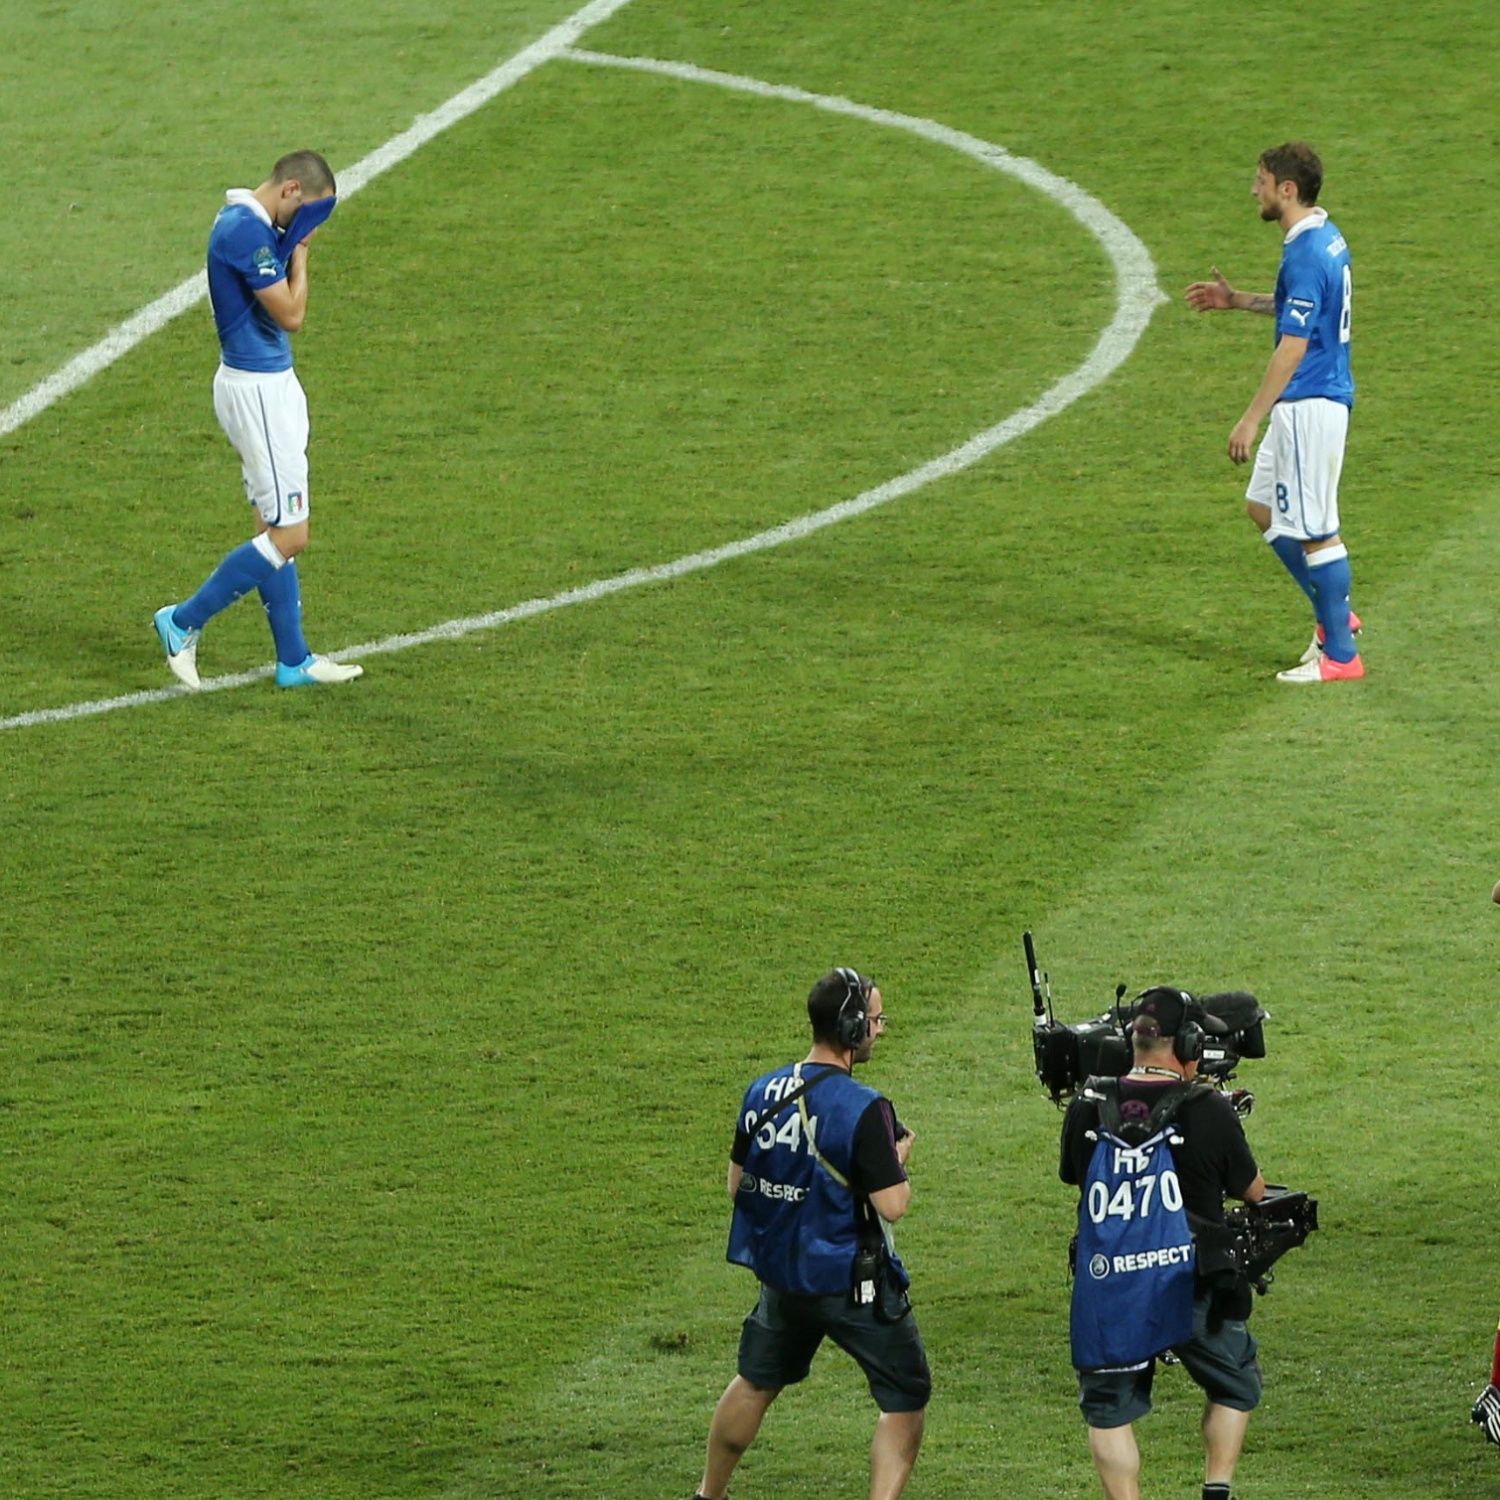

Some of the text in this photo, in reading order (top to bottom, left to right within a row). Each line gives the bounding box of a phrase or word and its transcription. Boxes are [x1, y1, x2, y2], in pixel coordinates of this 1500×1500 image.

[1276, 482, 1290, 514] 8
[760, 1178, 811, 1202] RESPEC
[1088, 1169, 1184, 1224] 0470
[1113, 1244, 1191, 1274] RESPECT
